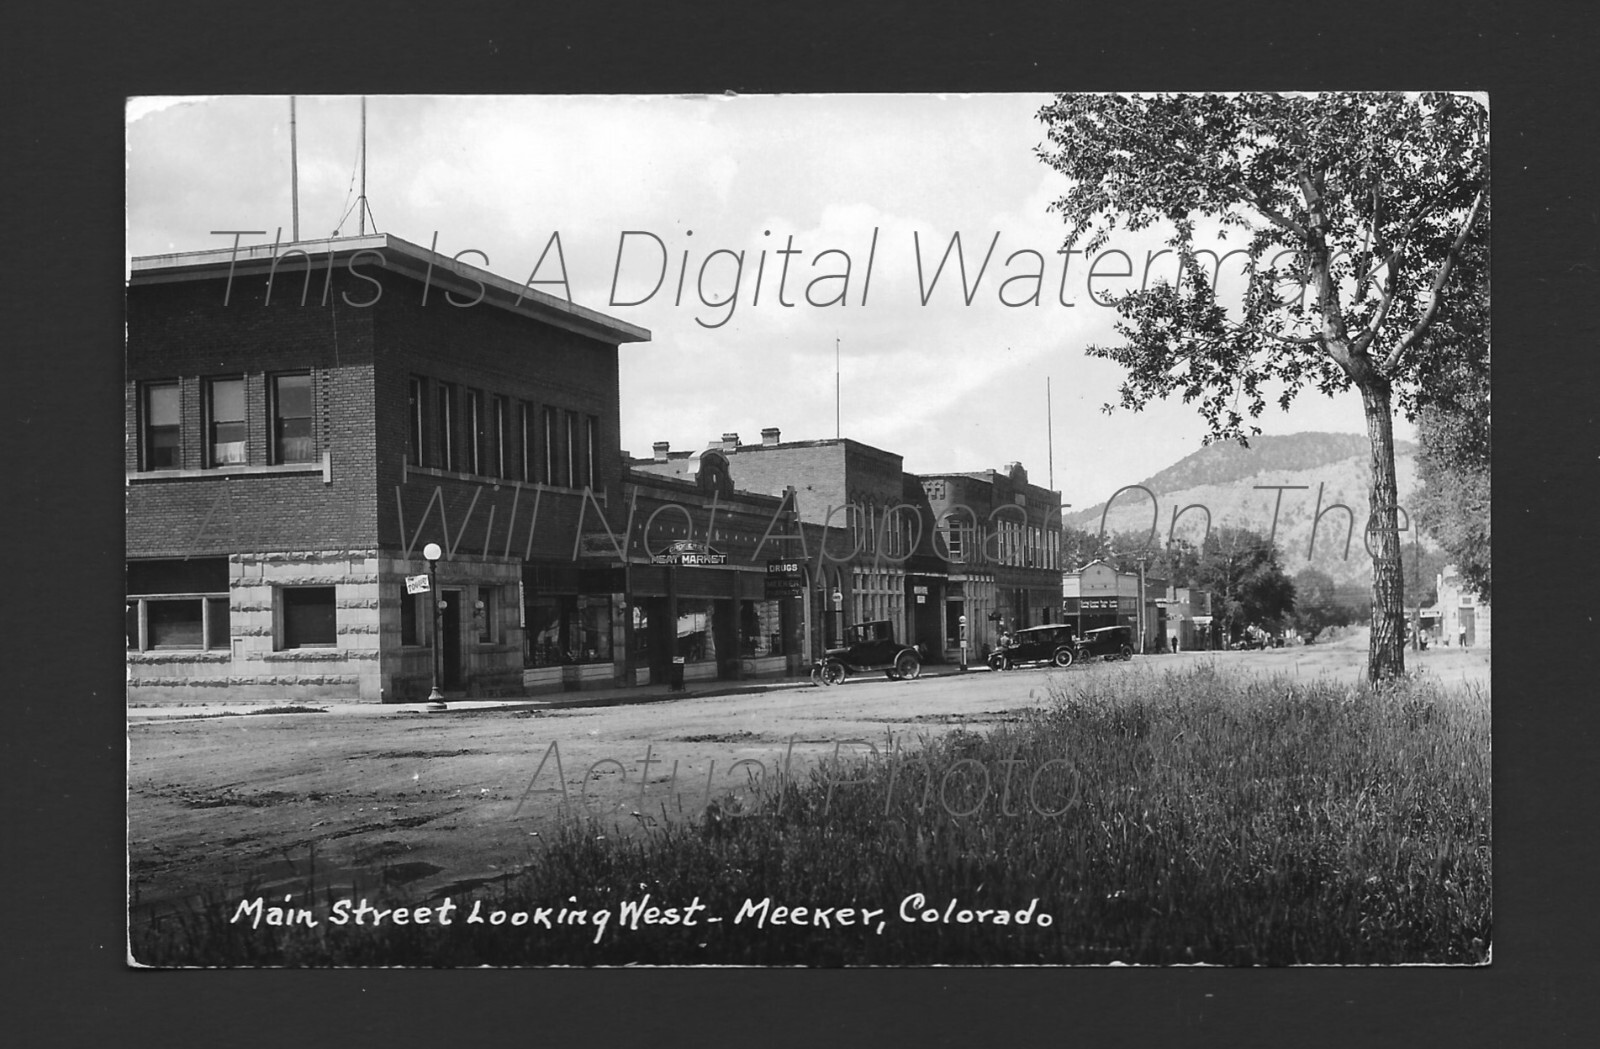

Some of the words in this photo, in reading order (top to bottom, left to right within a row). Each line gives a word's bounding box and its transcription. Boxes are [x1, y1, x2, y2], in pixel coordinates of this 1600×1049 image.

[651, 554, 679, 564] MEAT
[681, 554, 727, 564] MARKET
[769, 563, 798, 573] DRUGS
